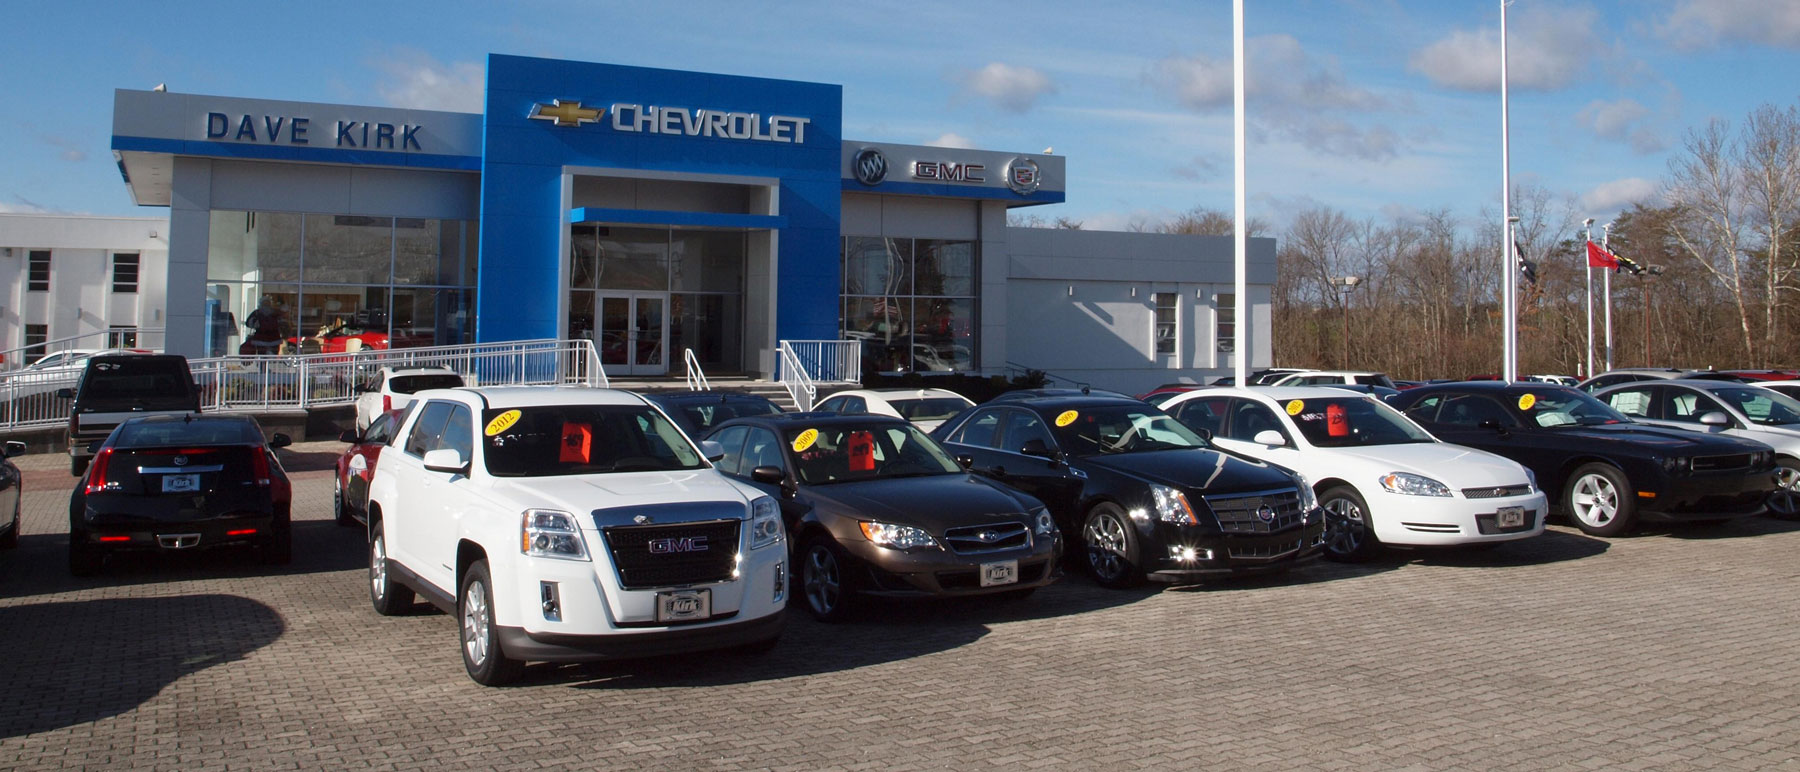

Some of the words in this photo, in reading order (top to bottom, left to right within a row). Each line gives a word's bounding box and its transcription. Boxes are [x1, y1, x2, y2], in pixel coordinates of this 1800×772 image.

[206, 112, 310, 144] DAVE
[336, 120, 422, 150] KIRK
[611, 103, 810, 144] CHEVROLET
[914, 161, 985, 182] GMC
[490, 412, 515, 432] 2012
[796, 430, 814, 449] 2009
[649, 536, 708, 553] GMC
